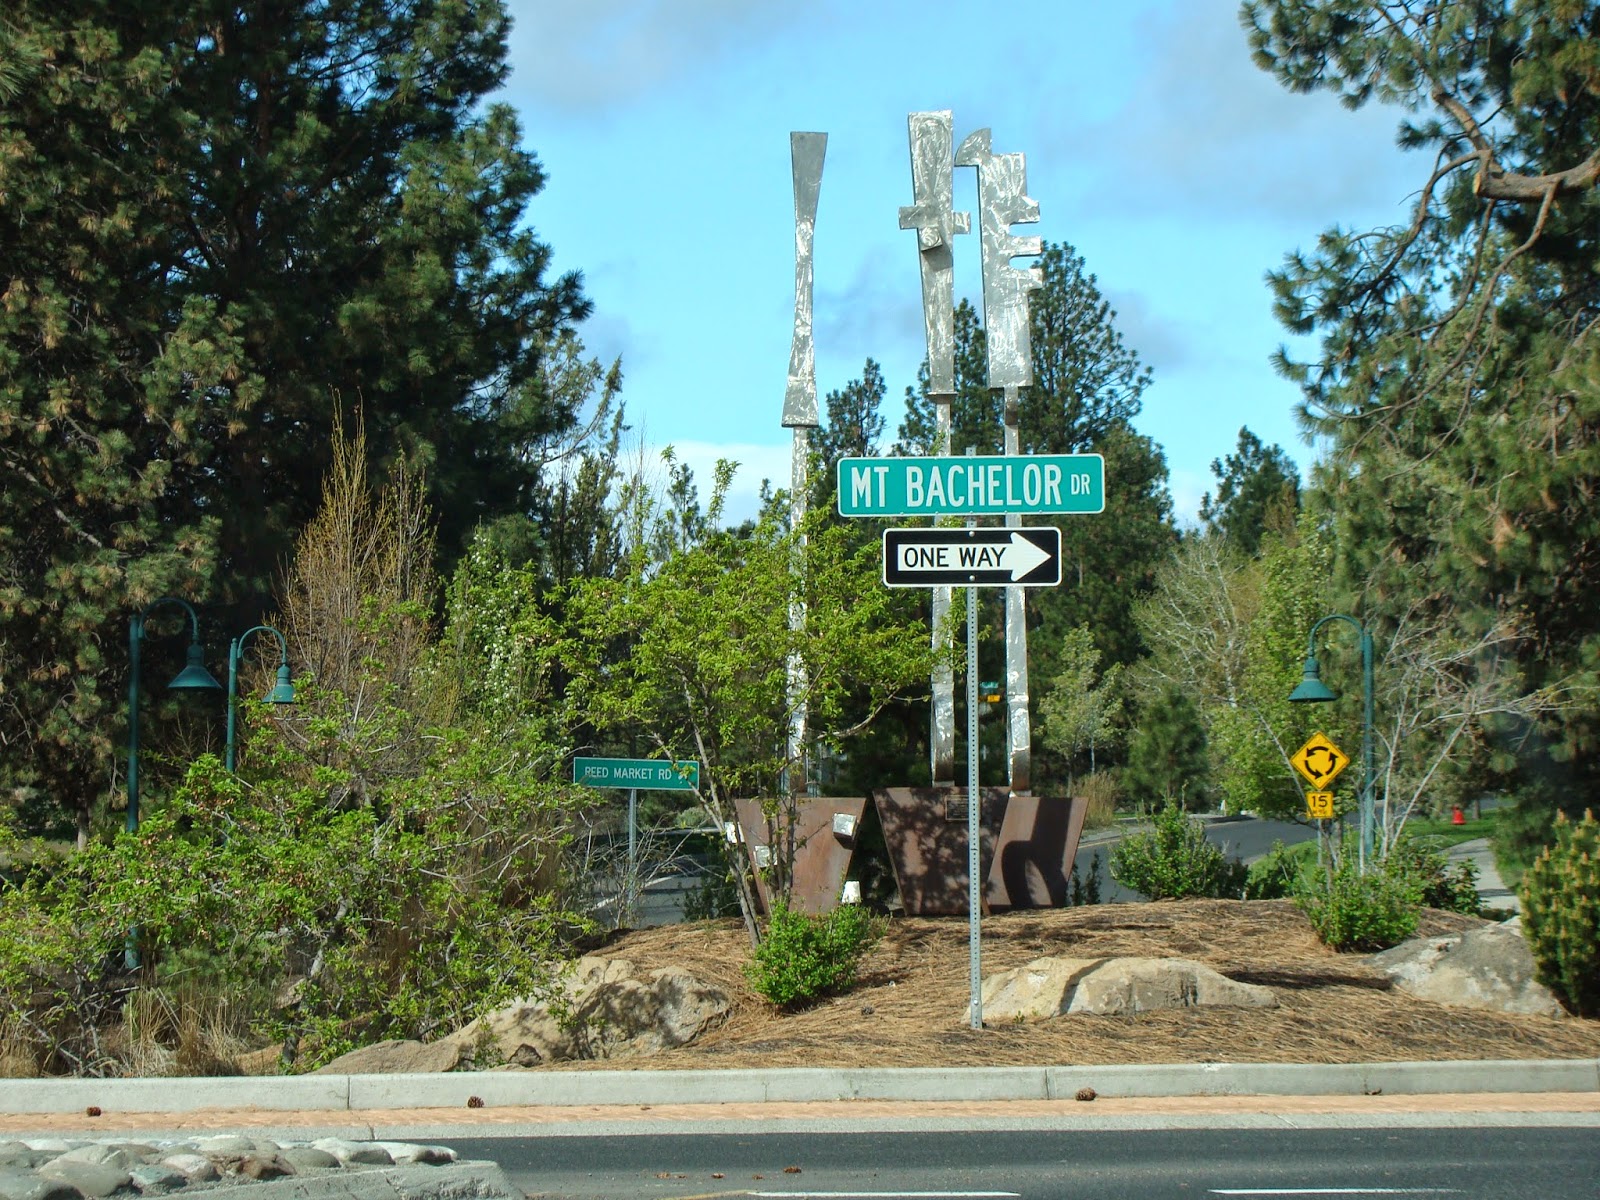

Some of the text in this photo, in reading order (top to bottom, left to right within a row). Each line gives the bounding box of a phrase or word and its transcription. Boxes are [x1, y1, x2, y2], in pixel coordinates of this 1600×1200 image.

[851, 463, 1091, 508] MT BACHELOR DR
[903, 547, 1007, 568] ONE WAY
[584, 766, 672, 780] REED MARKET RD
[1312, 795, 1328, 808] 15
